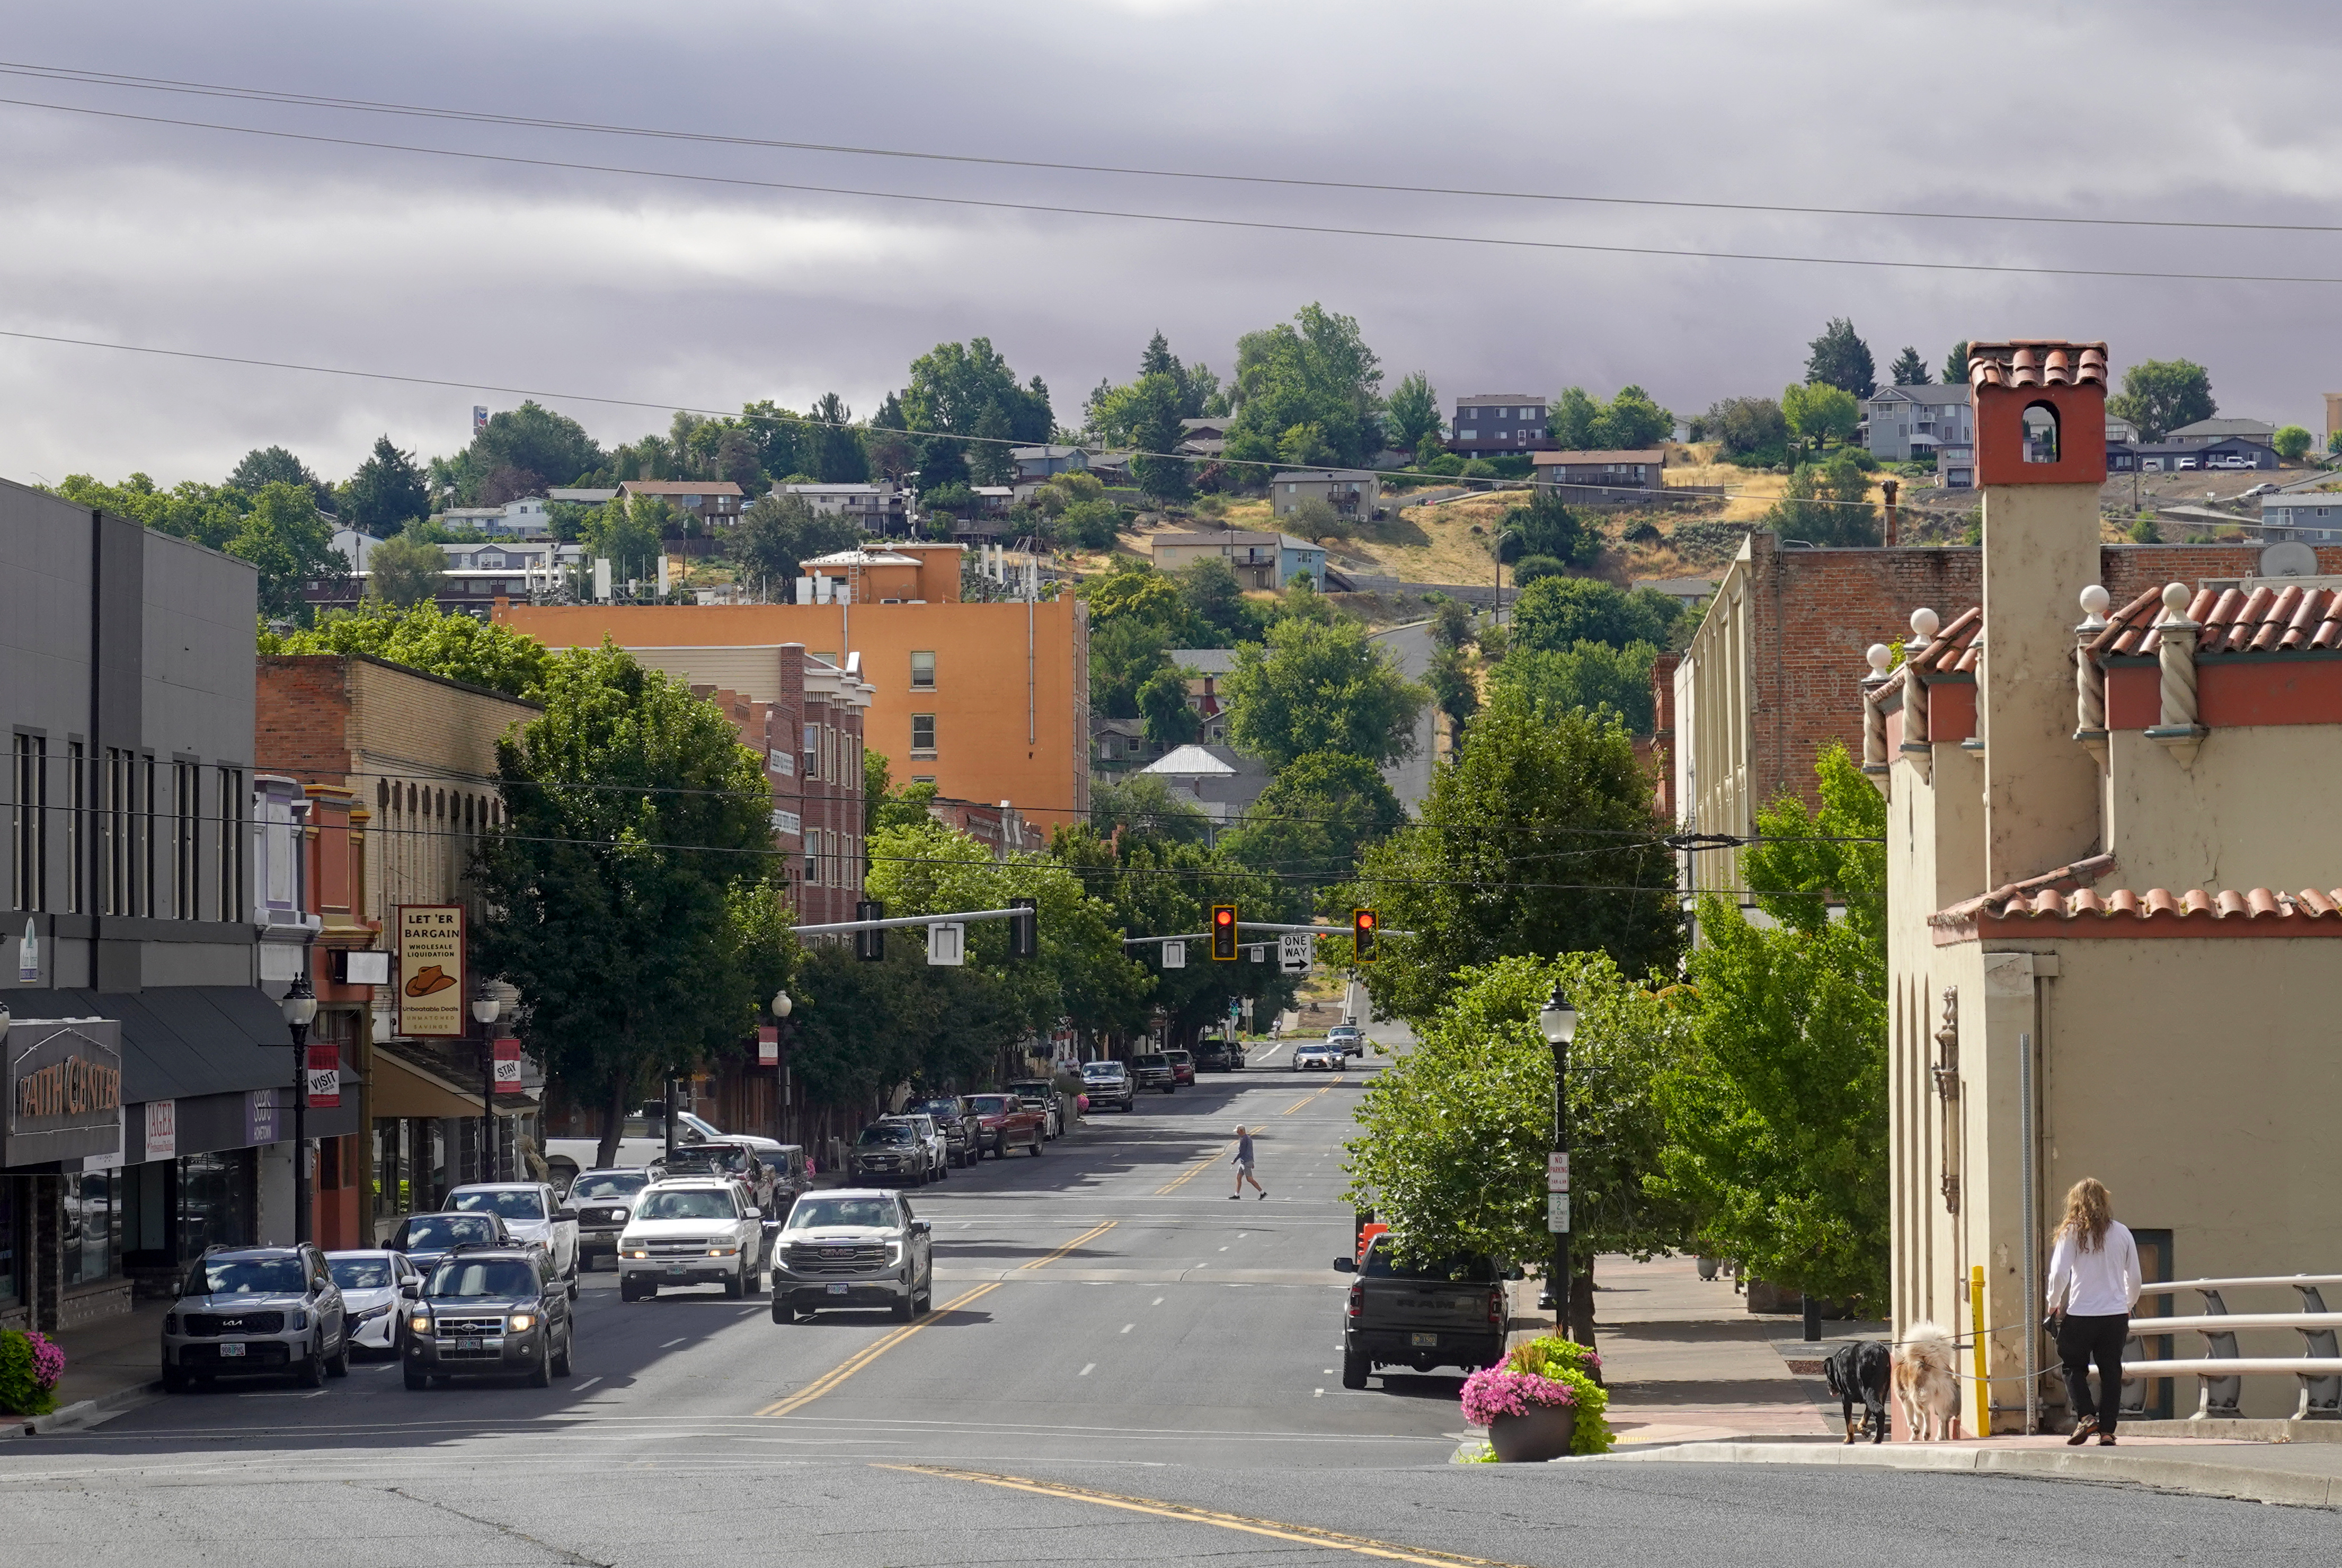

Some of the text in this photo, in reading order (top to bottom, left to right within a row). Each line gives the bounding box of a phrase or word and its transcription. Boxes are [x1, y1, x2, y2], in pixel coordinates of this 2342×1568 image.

[409, 914, 454, 924] LET 'ER
[404, 929, 460, 938] BARGAIN
[1285, 936, 1307, 946] ONE
[1285, 947, 1307, 957] WAY
[497, 1061, 516, 1078] STAY
[311, 1070, 336, 1091] VISIT
[21, 1054, 120, 1118] FAITH CENTER
[147, 1103, 174, 1149] JAGER
[1556, 1200, 1562, 1210] 2
[1397, 1298, 1456, 1309] RAM
